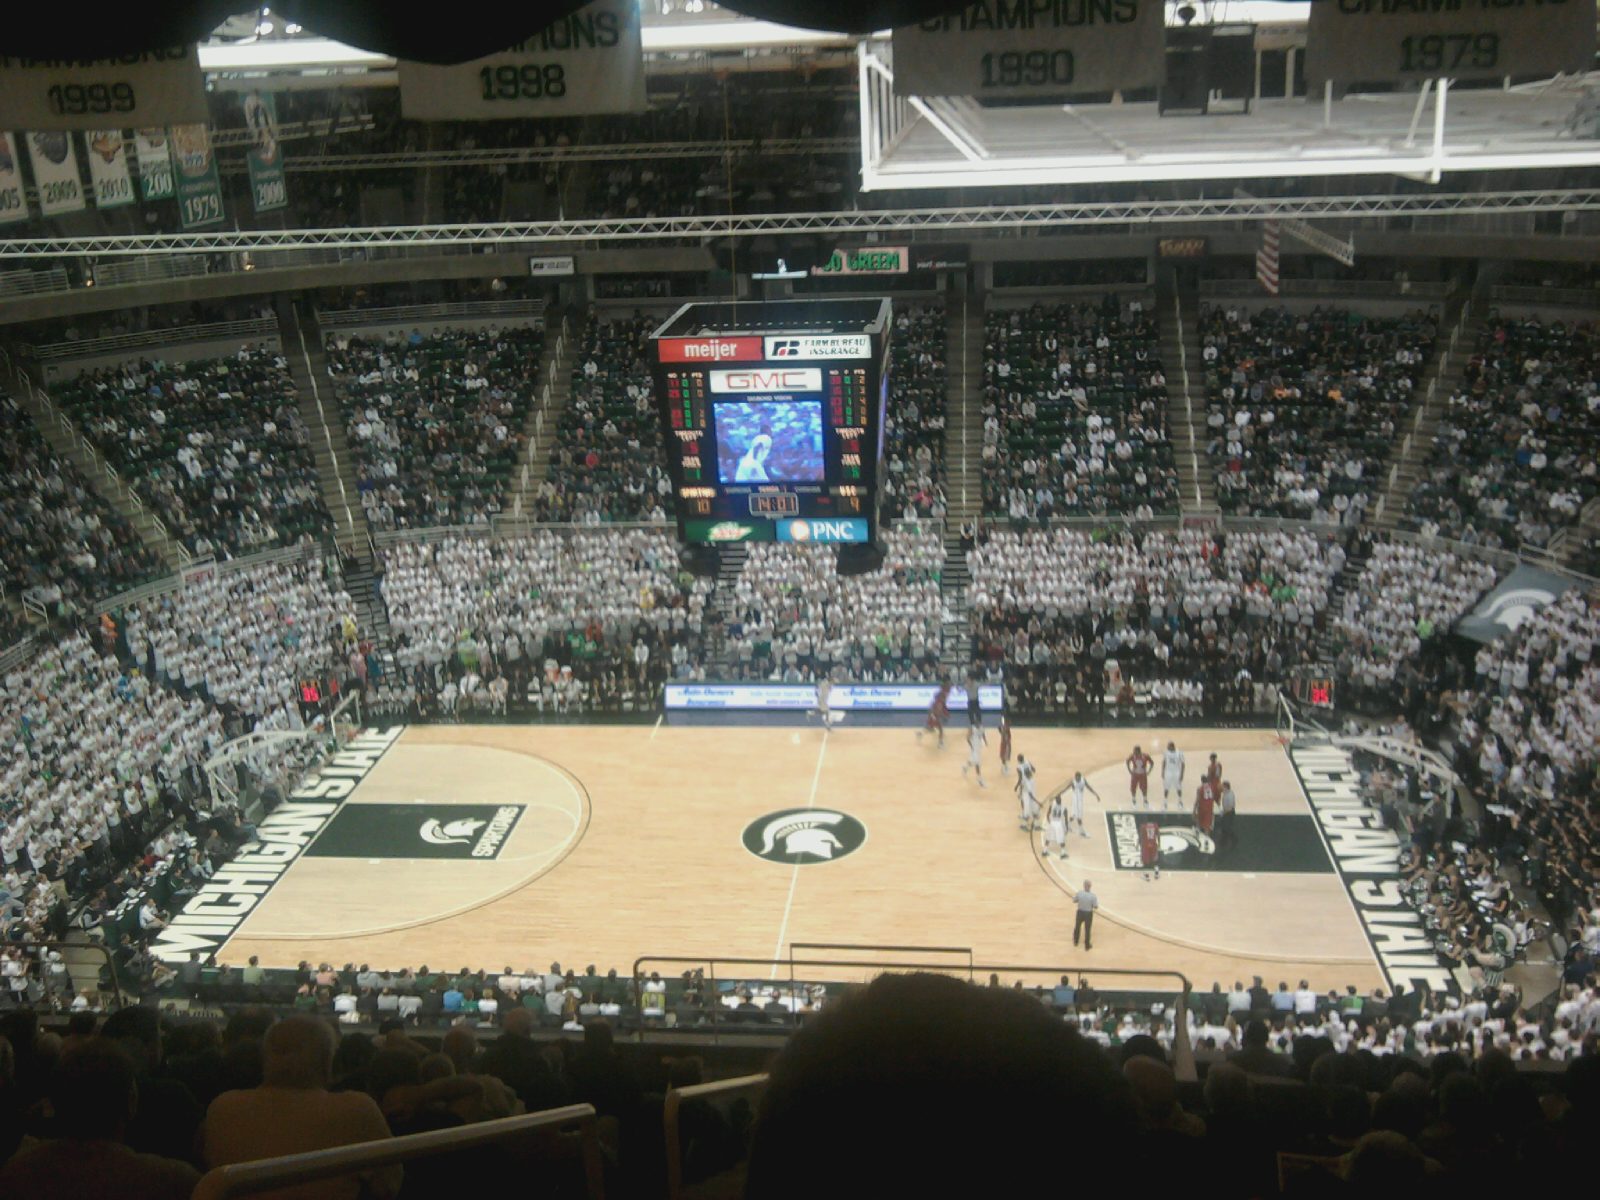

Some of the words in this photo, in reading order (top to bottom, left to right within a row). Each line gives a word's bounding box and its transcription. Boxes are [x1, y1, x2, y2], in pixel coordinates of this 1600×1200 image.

[1401, 32, 1500, 72] 1979
[480, 63, 566, 101] 1998
[981, 50, 1074, 88] 1990
[48, 83, 136, 115] 1999
[144, 173, 172, 197] 200
[185, 194, 219, 223] 1979
[684, 339, 737, 360] meijer
[726, 371, 808, 389] GMC
[813, 522, 854, 540] PNC
[149, 802, 338, 963] MICHIGAN
[291, 724, 404, 799] STATE
[1350, 880, 1462, 995] STATE
